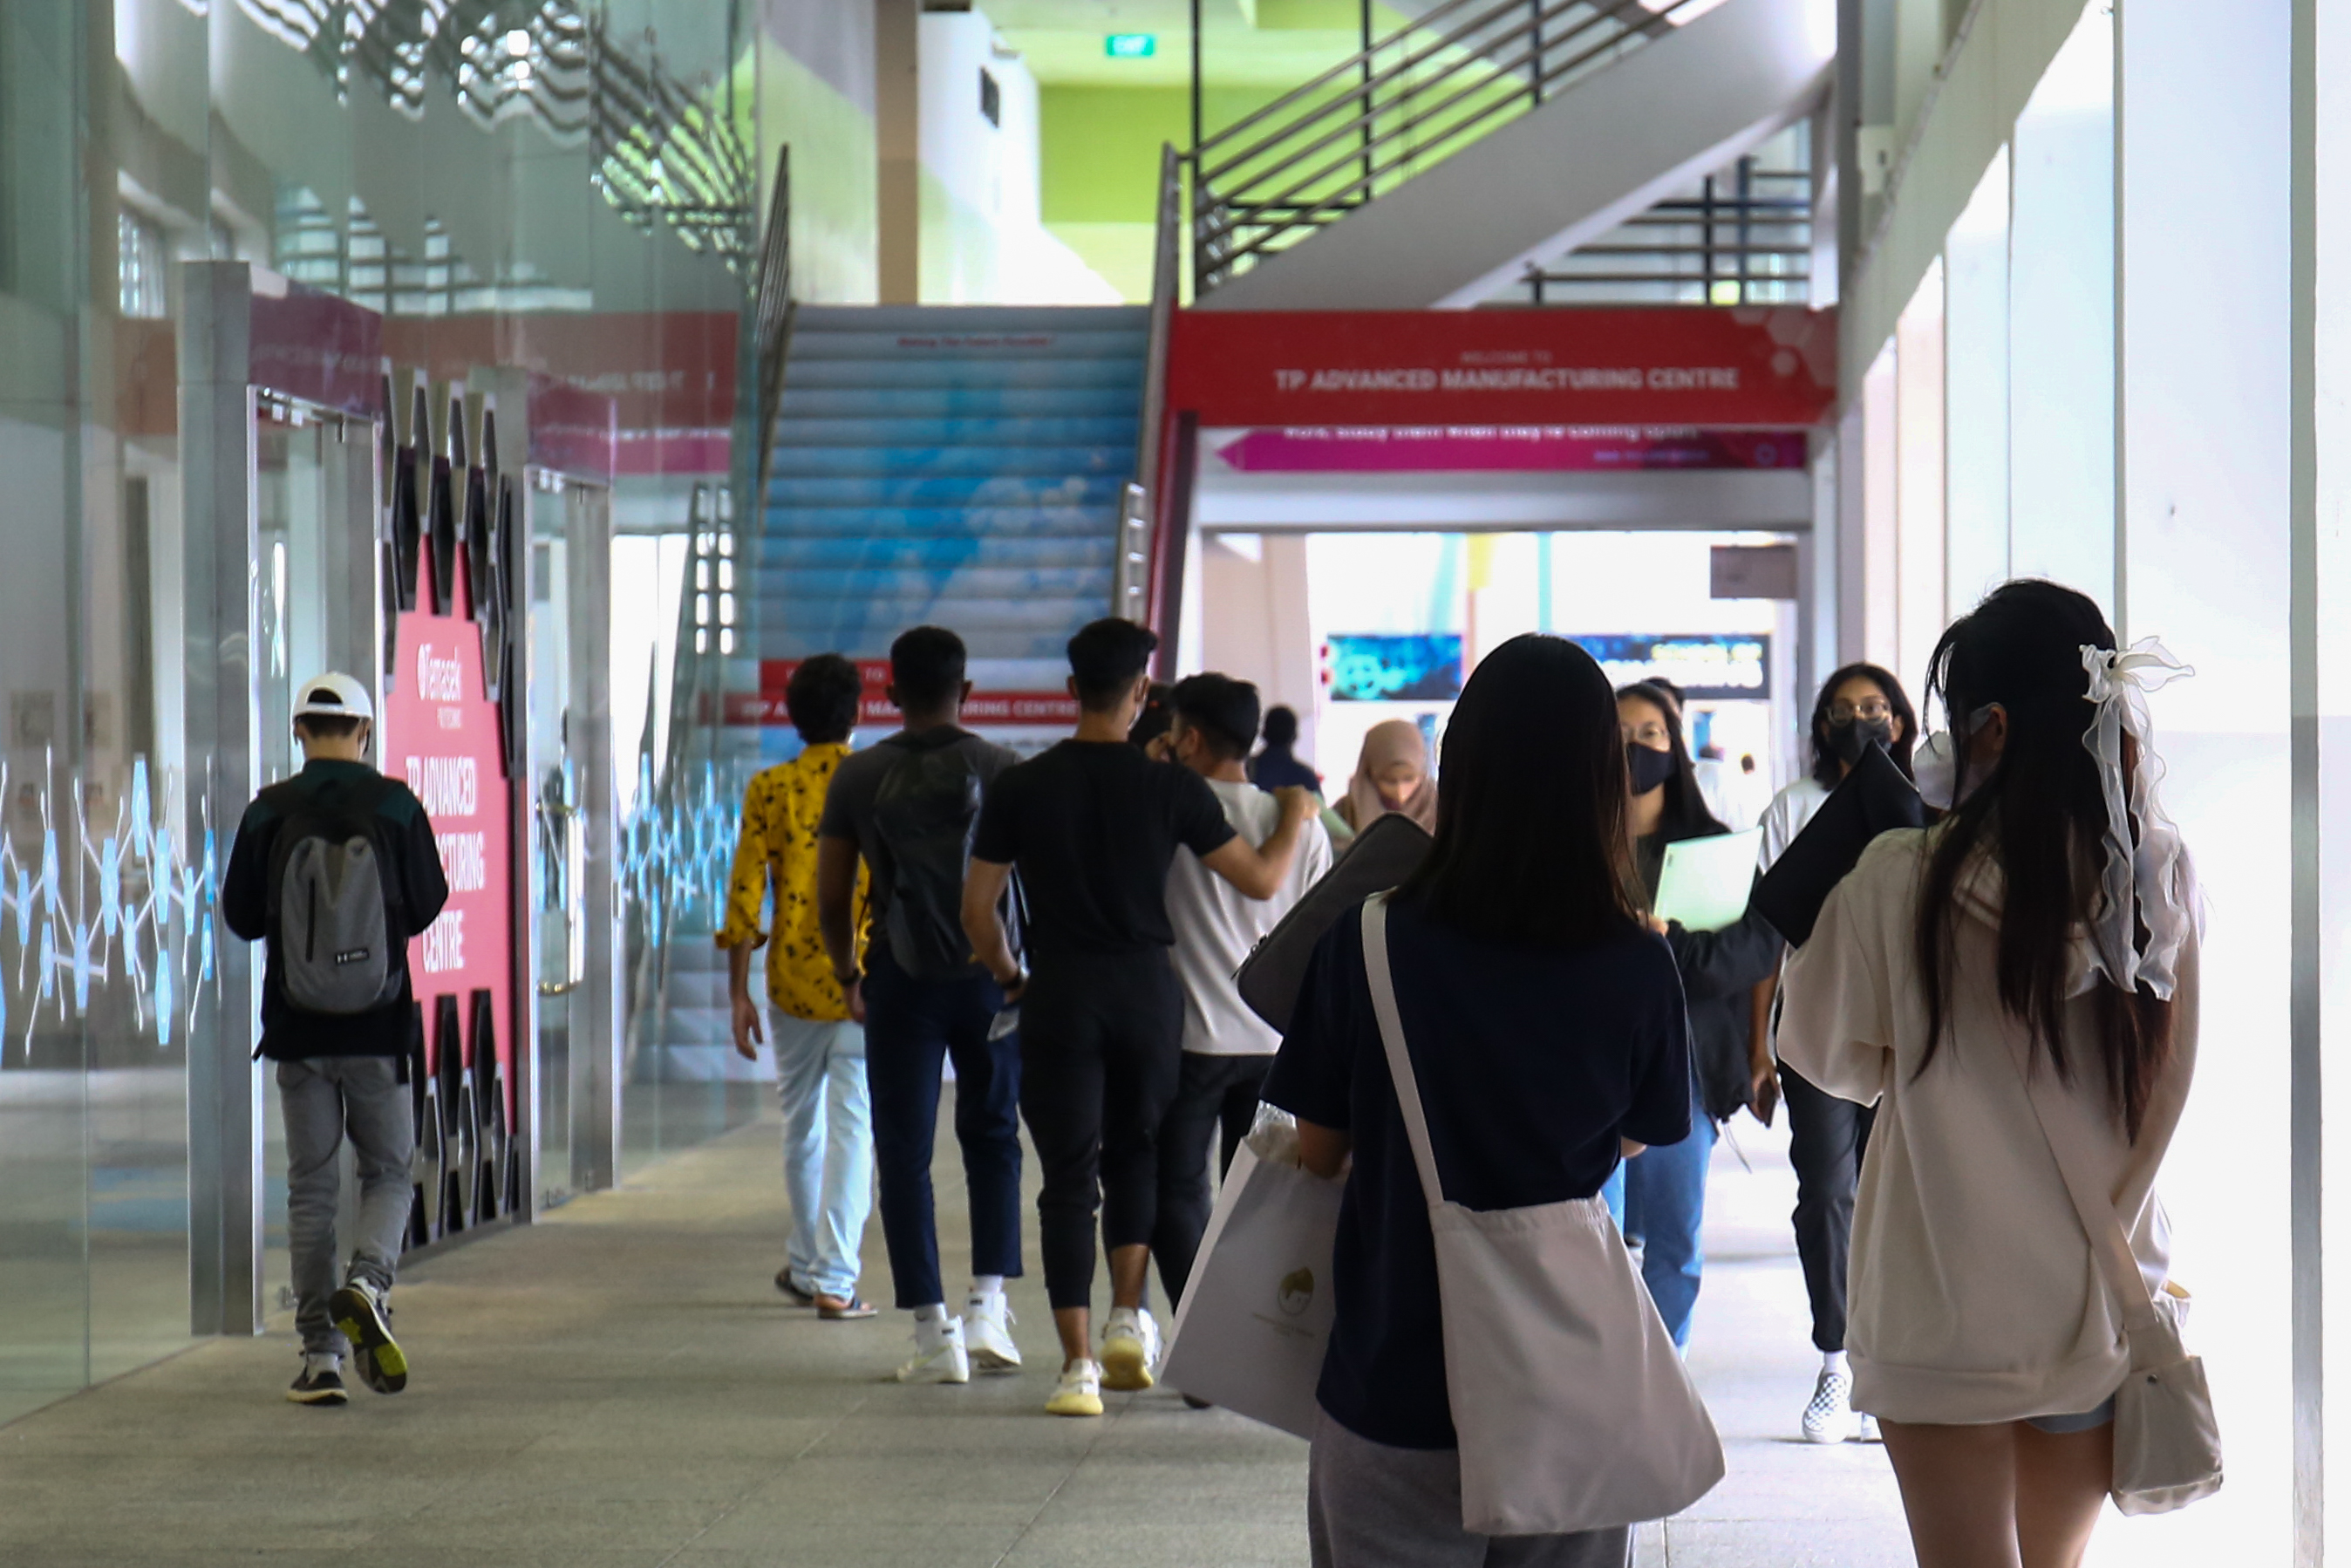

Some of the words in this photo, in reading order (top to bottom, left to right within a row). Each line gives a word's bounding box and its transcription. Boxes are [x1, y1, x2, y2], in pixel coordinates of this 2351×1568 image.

[1274, 368, 1307, 390] TP
[1309, 367, 1438, 390] ADVANCED
[1441, 367, 1643, 390] MANUFACTURING
[1646, 366, 1739, 390] CENTRE
[422, 755, 477, 816] ADVANCED
[436, 831, 485, 893] CTURING
[422, 910, 464, 972] CENTRE
